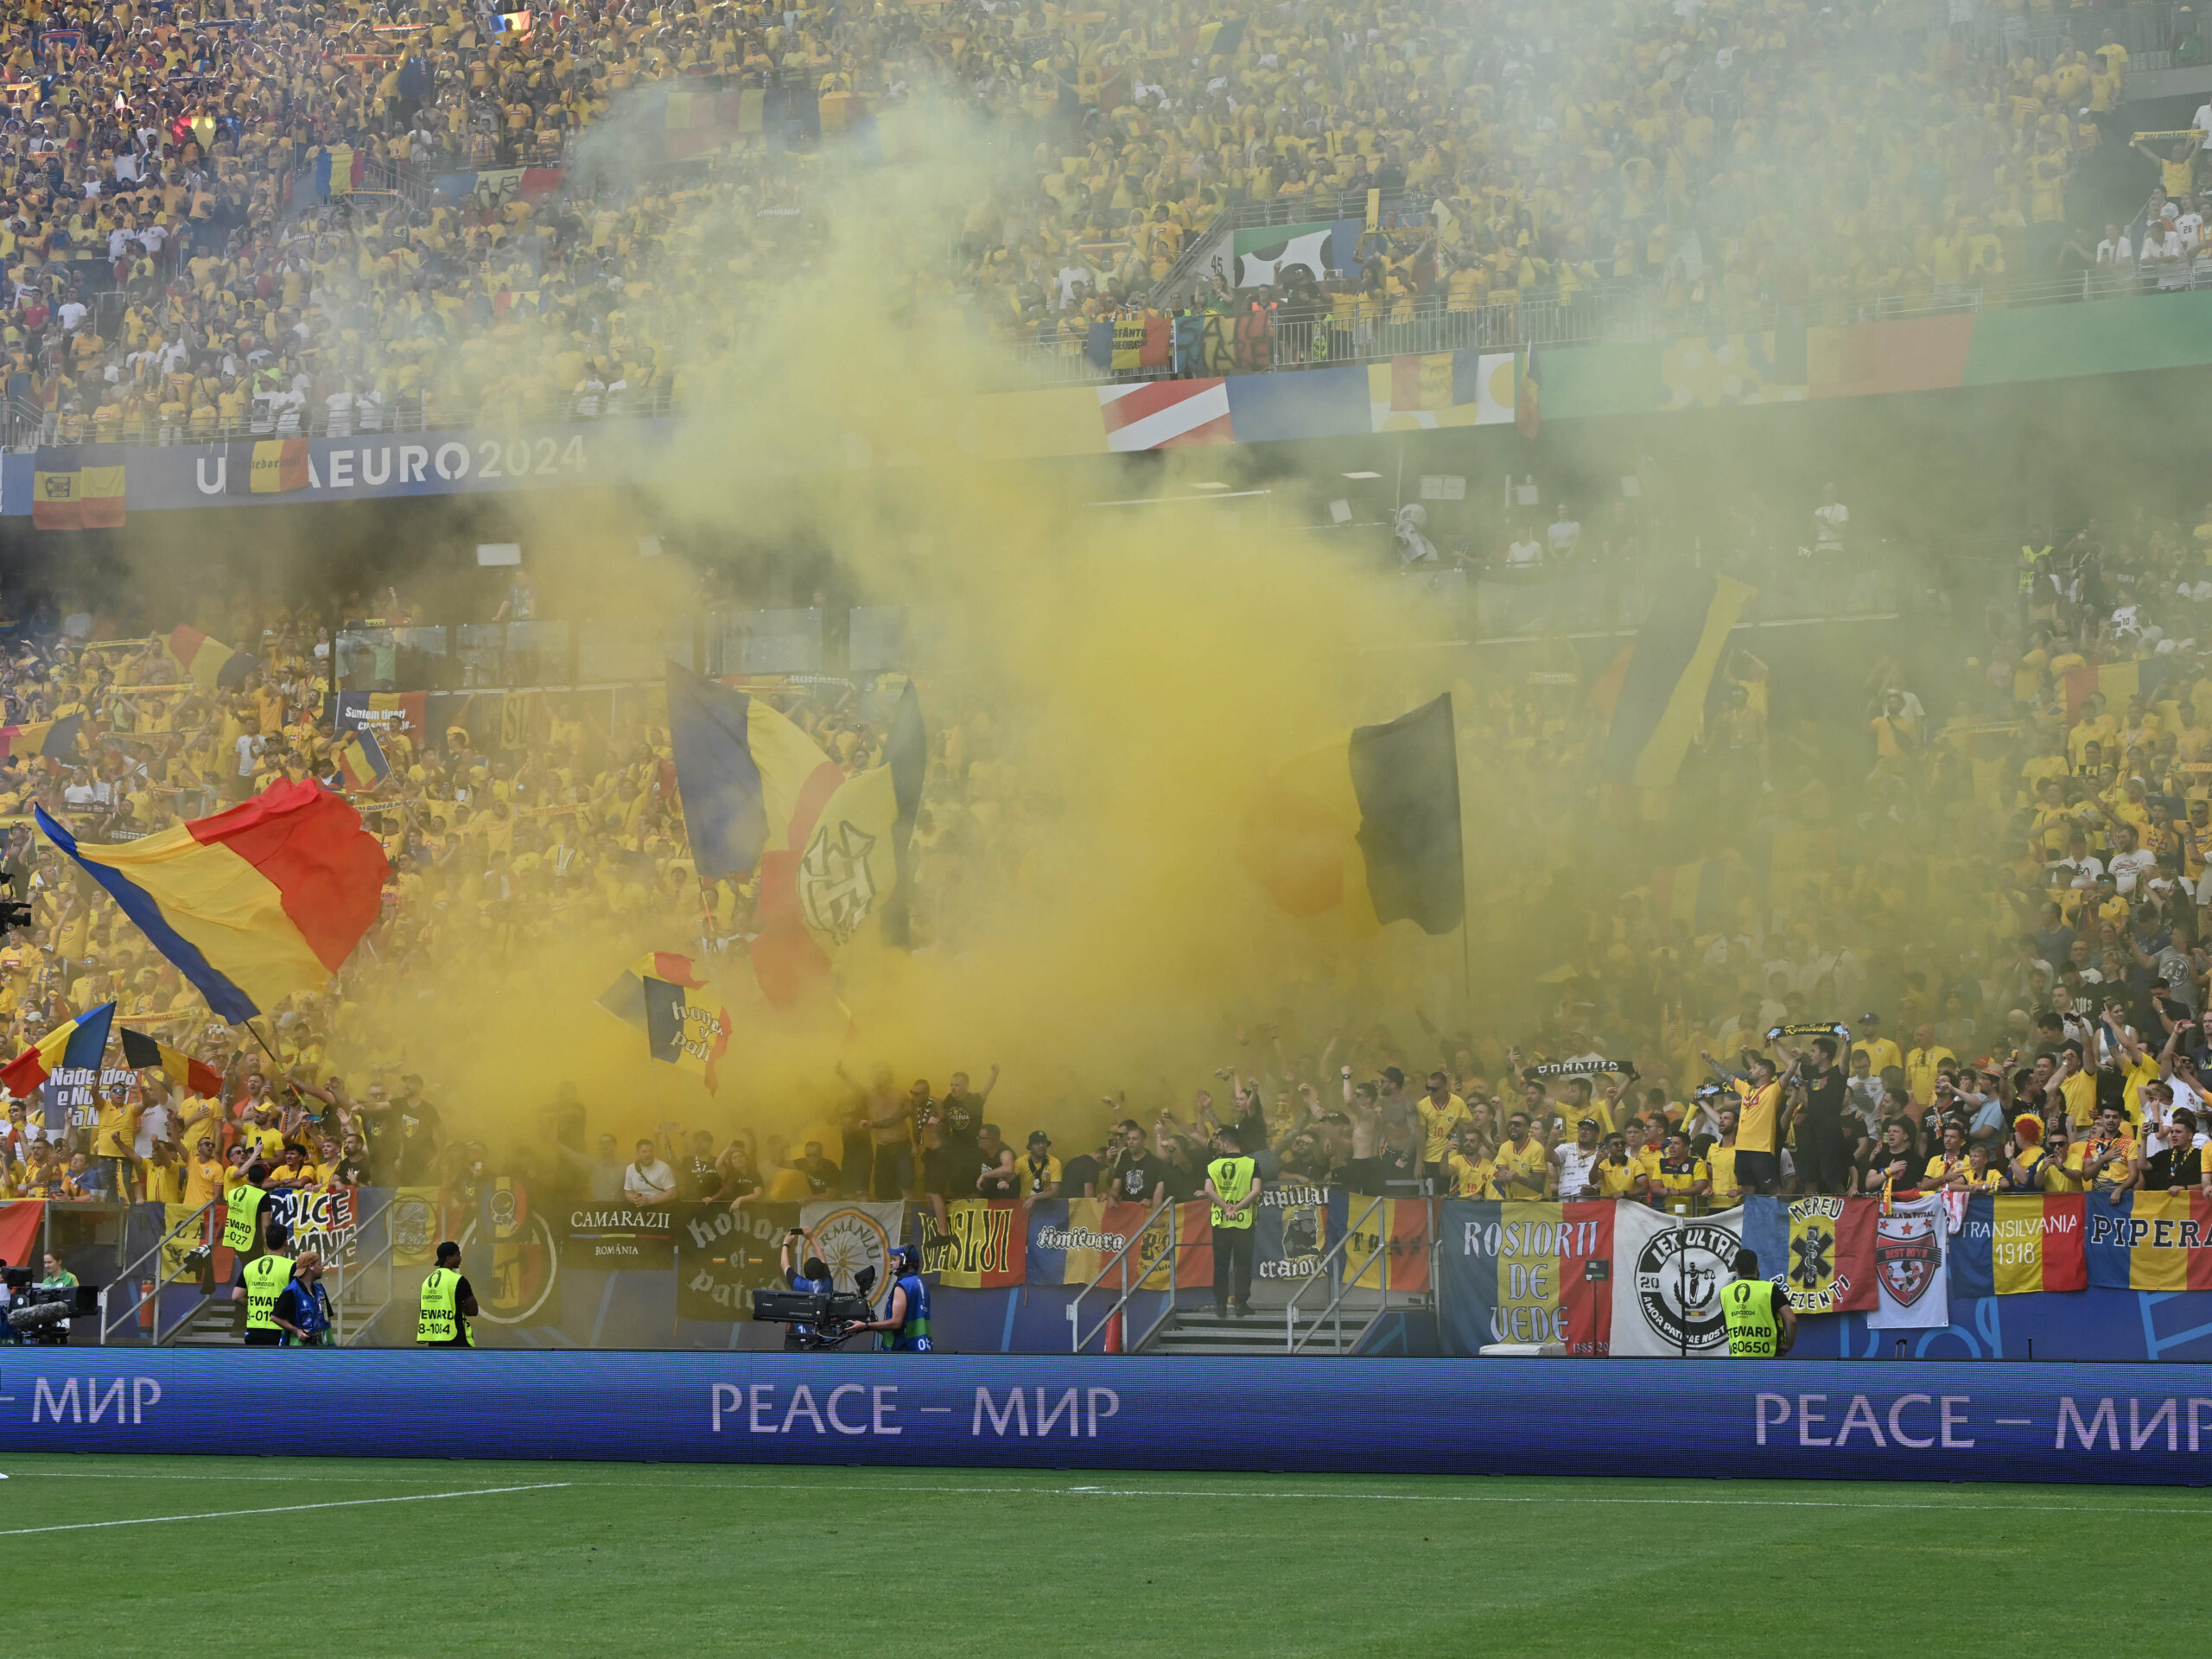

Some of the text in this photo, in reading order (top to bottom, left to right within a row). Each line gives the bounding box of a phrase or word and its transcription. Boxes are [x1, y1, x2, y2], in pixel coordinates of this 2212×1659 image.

[330, 442, 471, 488] EURO
[478, 435, 587, 478] 2024
[57, 1090, 69, 1106] e
[571, 1211, 671, 1229] CAMARAZII
[1789, 1196, 1845, 1224] MEREU
[225, 1230, 248, 1245] -027
[226, 1217, 251, 1234] EWARD
[1962, 1214, 2077, 1238] TRANSILVANIA
[1464, 1221, 1599, 1259] ROSIORII
[1651, 1229, 1741, 1268] LEX ULTRA
[1995, 1243, 2035, 1265] 1918
[729, 1247, 747, 1270] et
[1509, 1262, 1549, 1300] DE
[1640, 1276, 1660, 1289] 20
[421, 1309, 454, 1320] EWARD
[1490, 1306, 1570, 1344] VEDE
[1643, 1296, 1666, 1326] AMOR
[32, 1376, 162, 1424] МИР
[712, 1383, 902, 1434] PEACE
[972, 1387, 1119, 1436] МИР
[1755, 1392, 1975, 1447] PEACE
